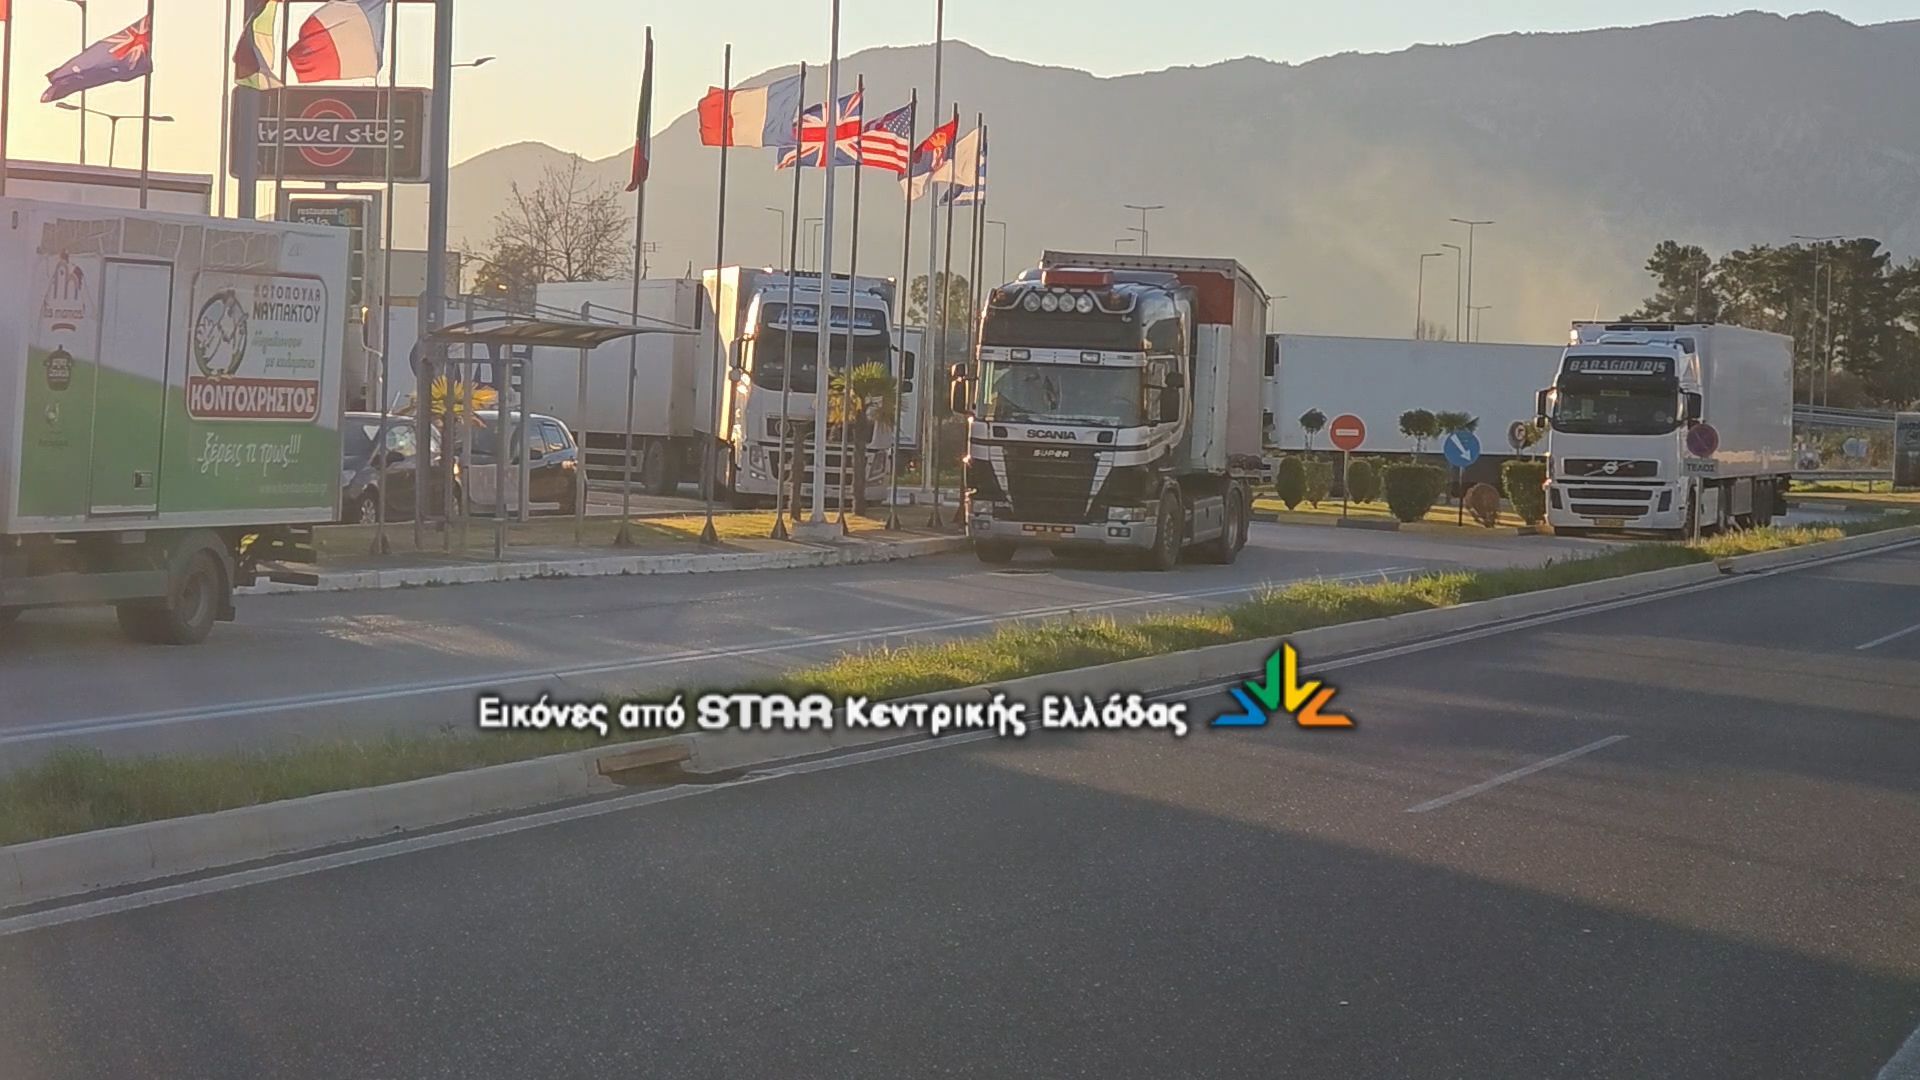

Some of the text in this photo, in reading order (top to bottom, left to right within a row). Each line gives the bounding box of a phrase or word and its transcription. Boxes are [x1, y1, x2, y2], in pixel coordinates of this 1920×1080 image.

[257, 122, 340, 142] travel
[253, 284, 321, 301] ΚΟΤΟΠΟΥΛΑ
[252, 301, 321, 323] ΝΑΥΠΑΚΤΟΥ
[1569, 359, 1667, 373] BARAGIOURIS
[191, 384, 315, 413] ΚΟΝΤΟΧΡΗΣΤΟΣ
[1026, 429, 1077, 440] SCANIA
[1032, 449, 1070, 458] SUPER
